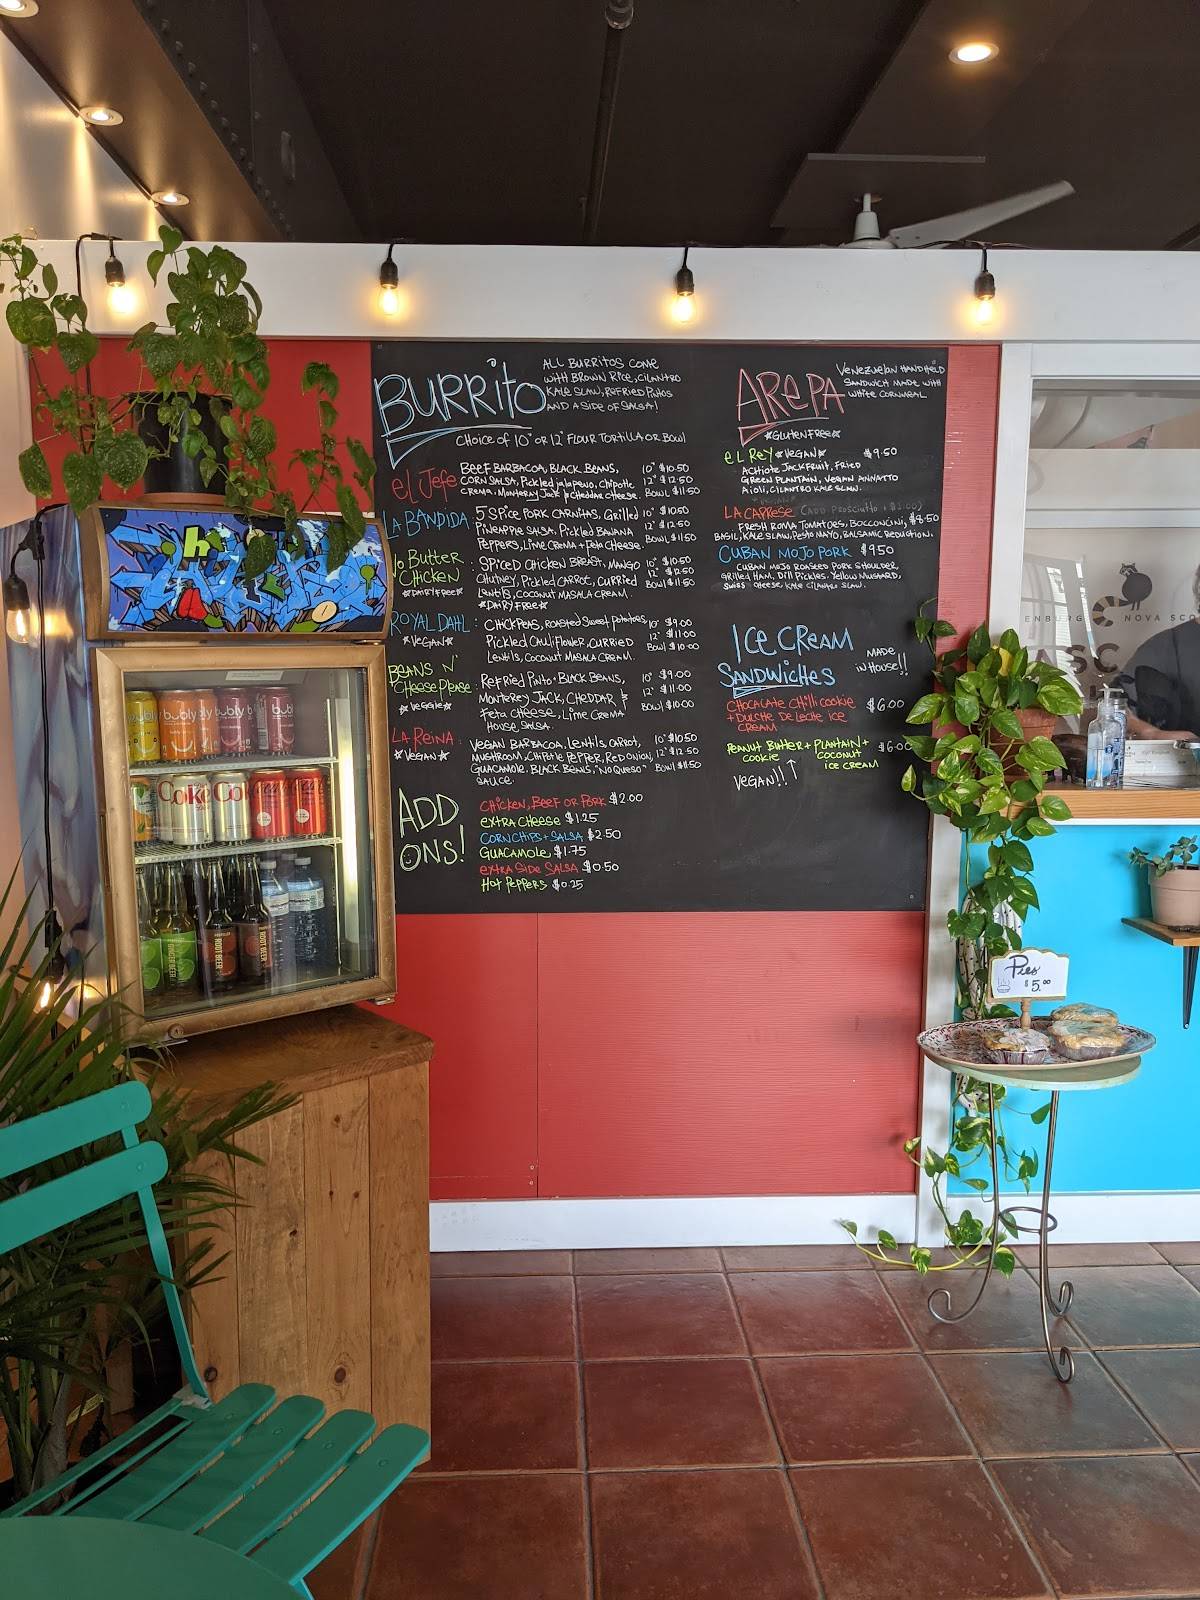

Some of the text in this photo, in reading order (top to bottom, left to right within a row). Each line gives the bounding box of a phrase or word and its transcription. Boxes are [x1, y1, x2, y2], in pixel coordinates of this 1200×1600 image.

[543, 358, 564, 370] ALL
[571, 372, 607, 383] BROWN
[547, 402, 569, 411] AND
[550, 464, 582, 474] BLACK
[475, 506, 487, 520] 5
[724, 505, 741, 519] LA
[405, 508, 469, 537] BANDIDA
[719, 545, 770, 563] CUBAN
[778, 546, 815, 560] MOJO
[818, 545, 852, 560] PORK
[736, 563, 766, 571] CUBAN
[390, 612, 469, 636] ROYAL DAHL
[866, 697, 905, 713] $6.00
[163, 707, 198, 723] bubly
[392, 727, 410, 744] LA
[608, 791, 643, 805] $2.00
[398, 788, 460, 838] ADD
[564, 811, 599, 825] $1.25
[587, 828, 622, 841] $2.50
[400, 824, 465, 871] ONS!
[553, 844, 587, 860] $1.75
[582, 860, 620, 873] $0.50
[551, 879, 584, 892] $0.25
[1004, 955, 1041, 979] Pies
